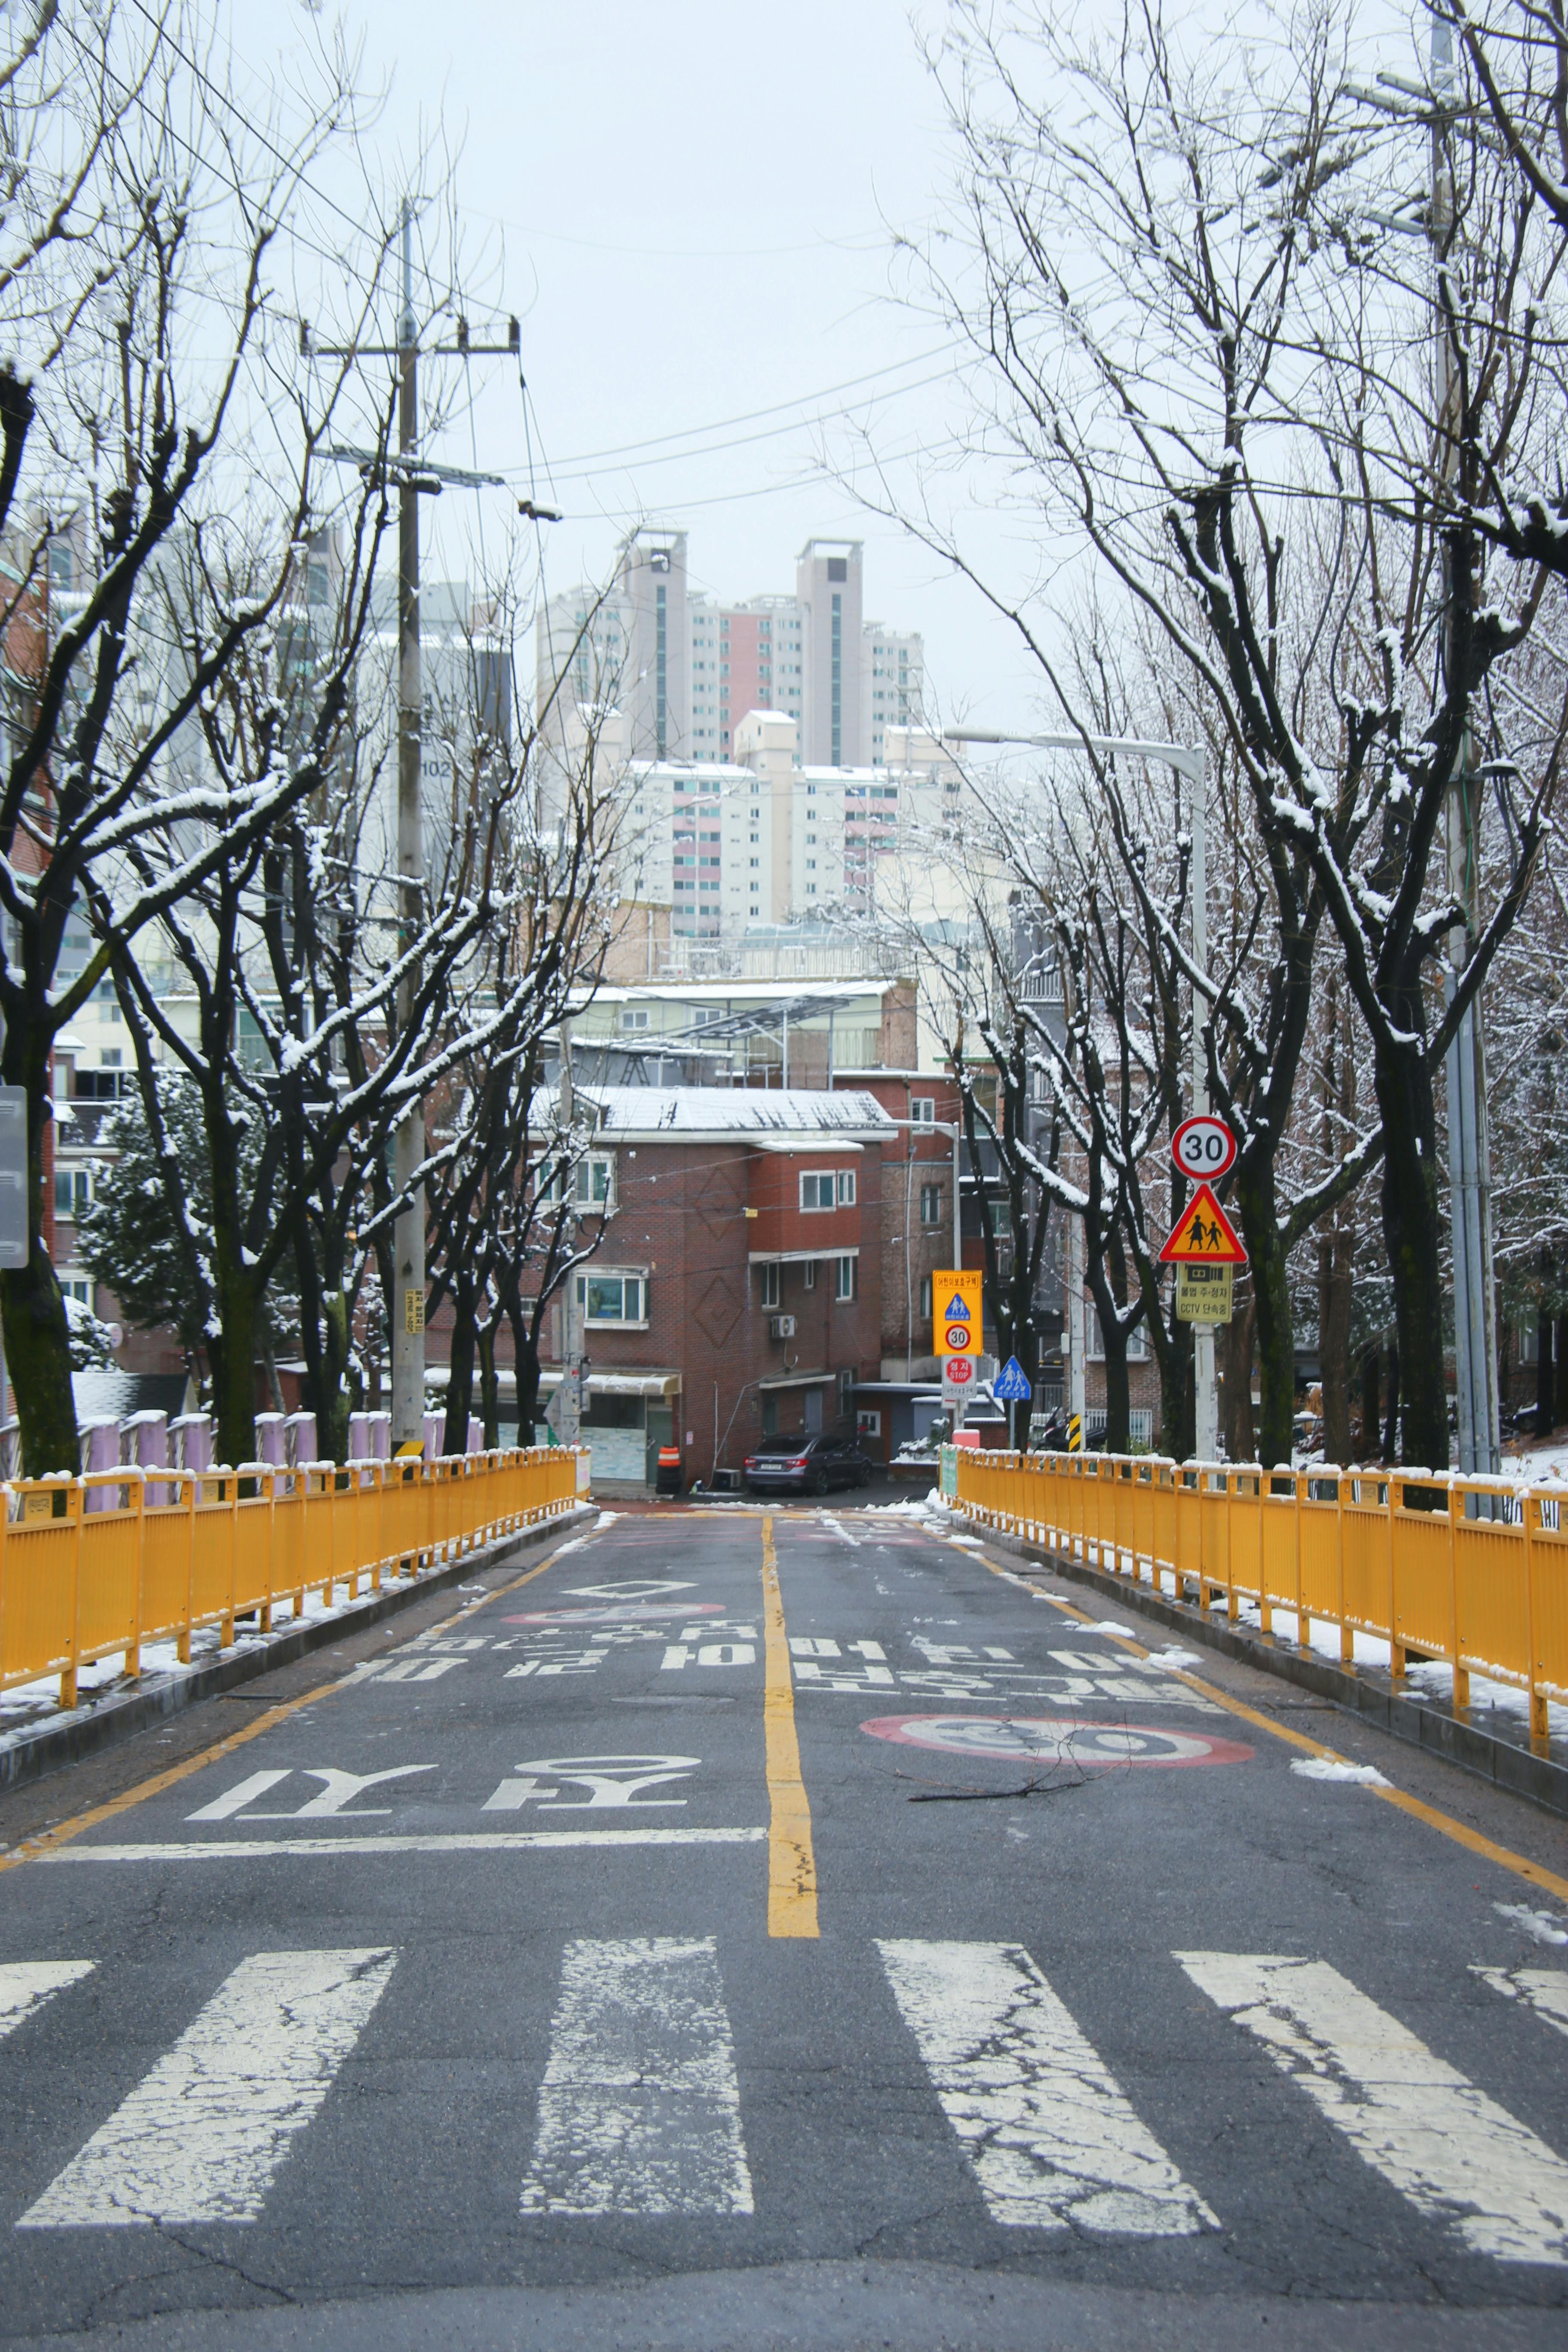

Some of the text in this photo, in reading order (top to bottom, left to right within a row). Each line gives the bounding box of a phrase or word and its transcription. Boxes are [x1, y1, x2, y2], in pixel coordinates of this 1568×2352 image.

[1185, 1134, 1223, 1161] 30
[938, 1277, 976, 1286] 어린이보호구역
[1182, 1286, 1227, 1298] 불법 주·정차
[1181, 1303, 1226, 1315] CCTV 단속중
[951, 1331, 965, 1344] 30
[788, 1637, 1168, 1675] 어린이
[793, 1661, 1230, 1715] 보호구역
[936, 1721, 1177, 1755] 30
